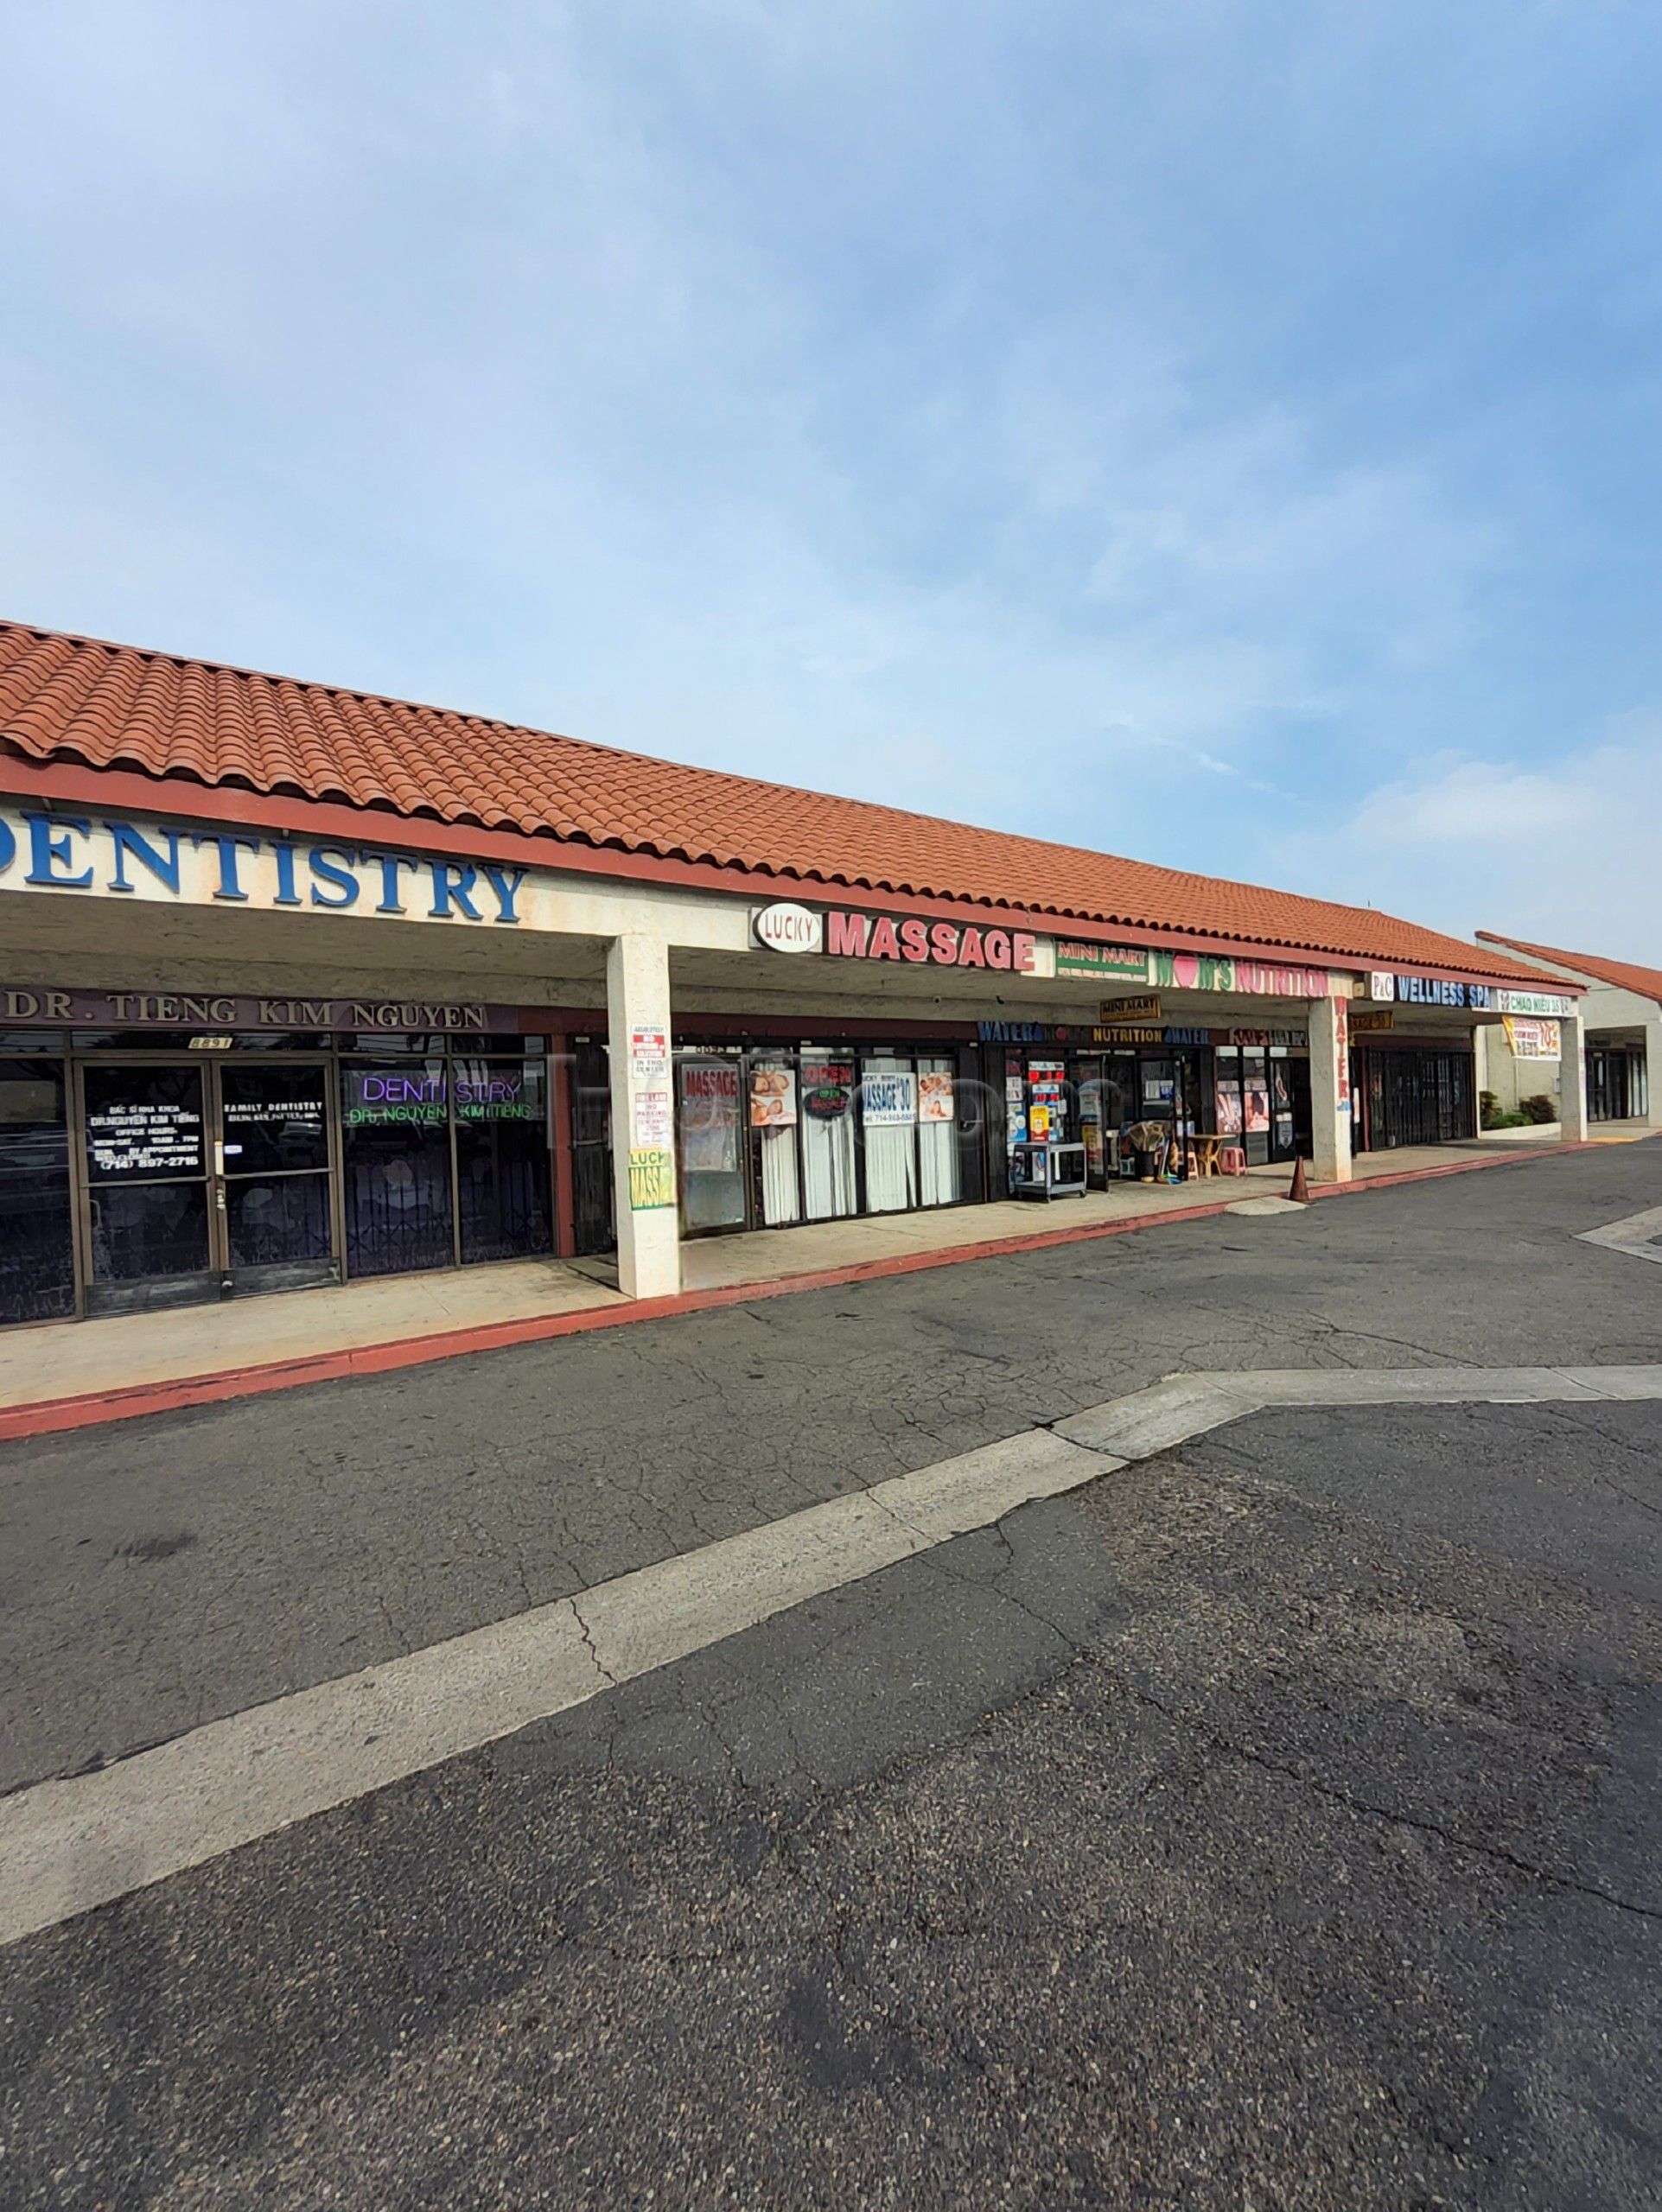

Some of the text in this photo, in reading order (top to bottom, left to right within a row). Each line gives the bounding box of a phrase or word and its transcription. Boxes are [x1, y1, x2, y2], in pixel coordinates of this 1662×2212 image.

[0, 810, 529, 923] ENTISTRY
[764, 908, 813, 942] LUCKY
[827, 911, 1035, 971] MASSAGE
[1058, 941, 1147, 967] MINI MART
[1398, 976, 1491, 1007] WELLNESS SPA
[106, 995, 237, 1023] TIENG
[259, 1001, 334, 1026] KIM
[352, 1003, 485, 1028] NGUYEN
[191, 1039, 229, 1048] 8891
[977, 1021, 1034, 1042] WATER
[1093, 1027, 1162, 1043] NUTRITION
[1172, 1027, 1209, 1045] WATER
[1334, 995, 1348, 1099] WATER
[685, 1071, 737, 1096] MASSAGE
[806, 1065, 852, 1084] OPEN
[363, 1077, 521, 1104] DENTISTRY
[224, 1102, 322, 1112] FAMILY DENTISTRY
[384, 1104, 449, 1122] NGUYEN
[459, 1105, 484, 1119] KIM
[100, 1156, 199, 1171] (714) 897-2716
